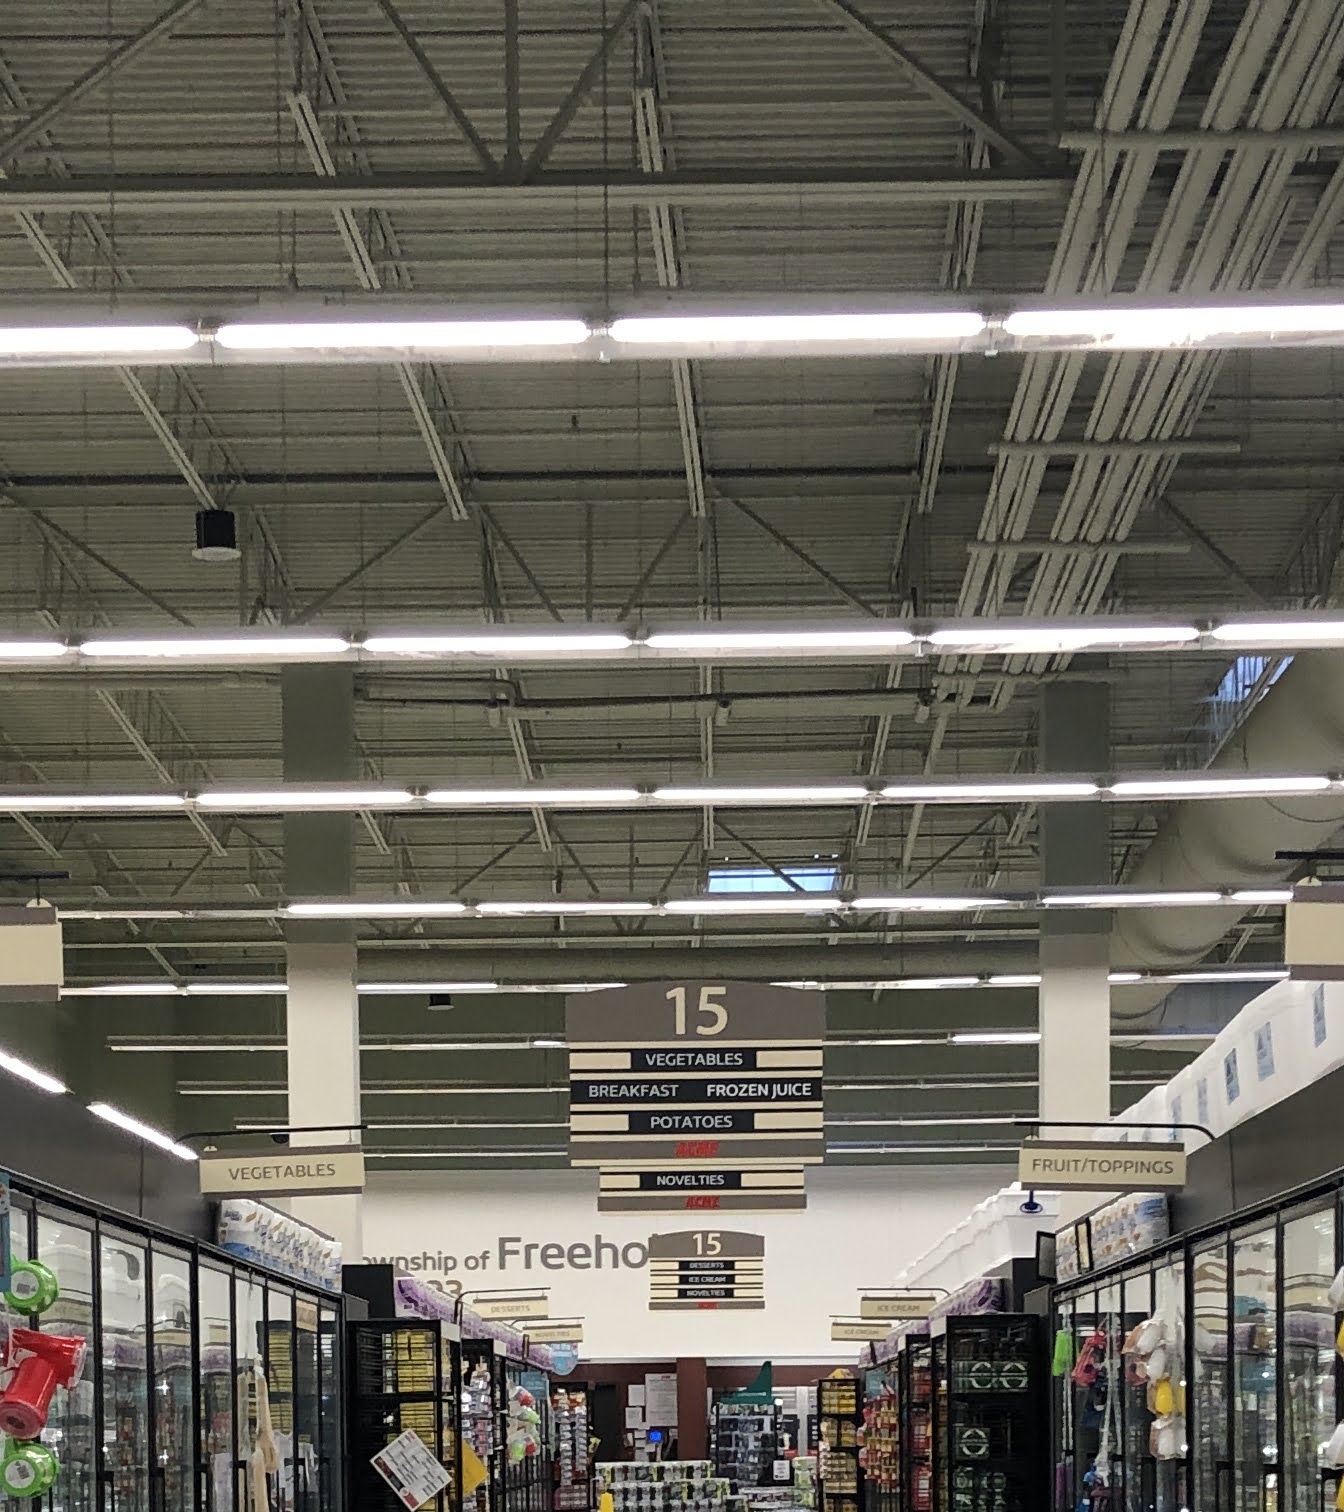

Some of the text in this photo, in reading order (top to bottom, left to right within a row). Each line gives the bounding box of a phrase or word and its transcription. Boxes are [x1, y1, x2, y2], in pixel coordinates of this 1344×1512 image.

[666, 986, 729, 1036] 15
[645, 1053, 743, 1067] VEGETABLES
[588, 1084, 680, 1098] BREAKFAST
[706, 1083, 812, 1100] FROZEN JUICE
[650, 1115, 734, 1129] POTATOES
[228, 1163, 336, 1181] VEGETABLES
[1032, 1157, 1174, 1175] FRUIT/TOPPINGS
[656, 1174, 725, 1186] NOVELTIES
[464, 1250, 490, 1271] of
[498, 1234, 652, 1270] Freeho
[692, 1233, 722, 1256] 15
[891, 1304, 920, 1312] CREAM
